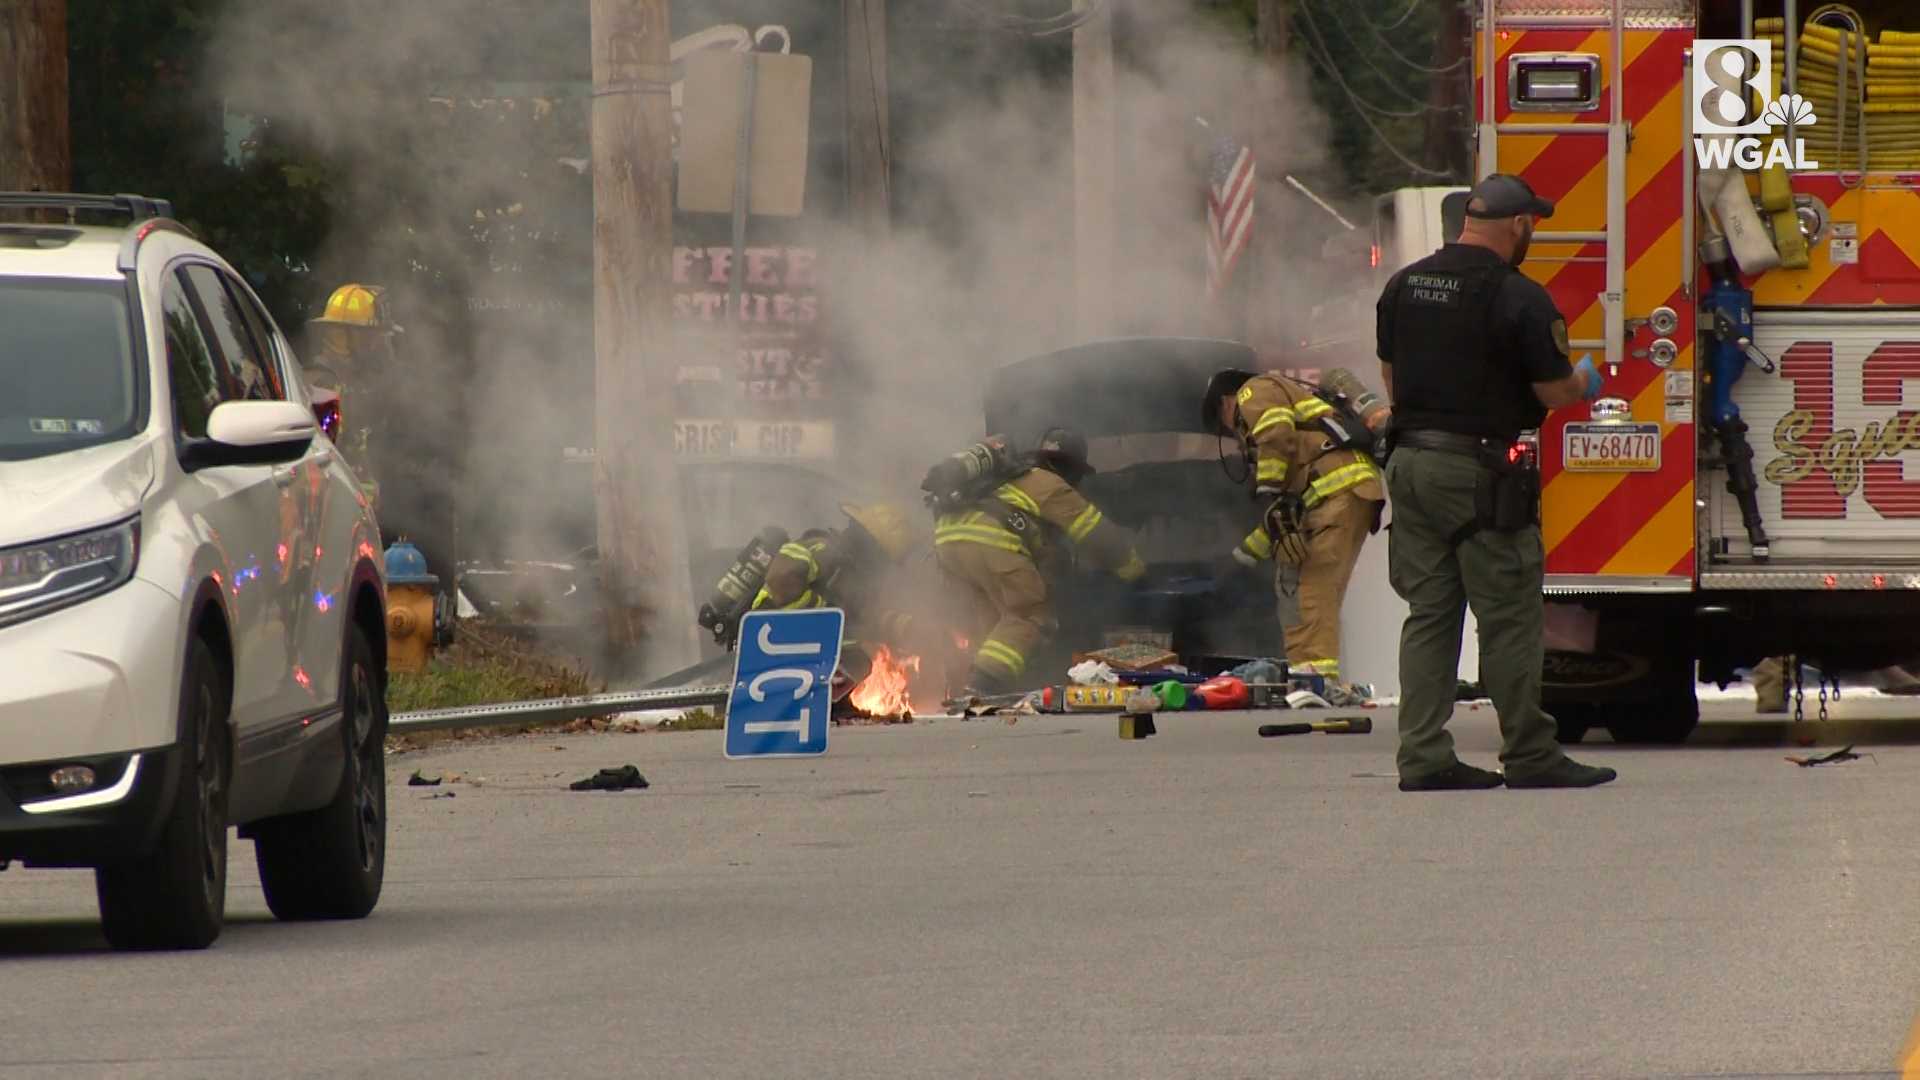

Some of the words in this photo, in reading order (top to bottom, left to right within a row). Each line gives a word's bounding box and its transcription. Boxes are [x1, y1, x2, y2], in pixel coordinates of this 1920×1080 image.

[1408, 275, 1460, 291] REGIONAL
[1413, 288, 1450, 303] POLICE
[744, 623, 821, 743] JCT
